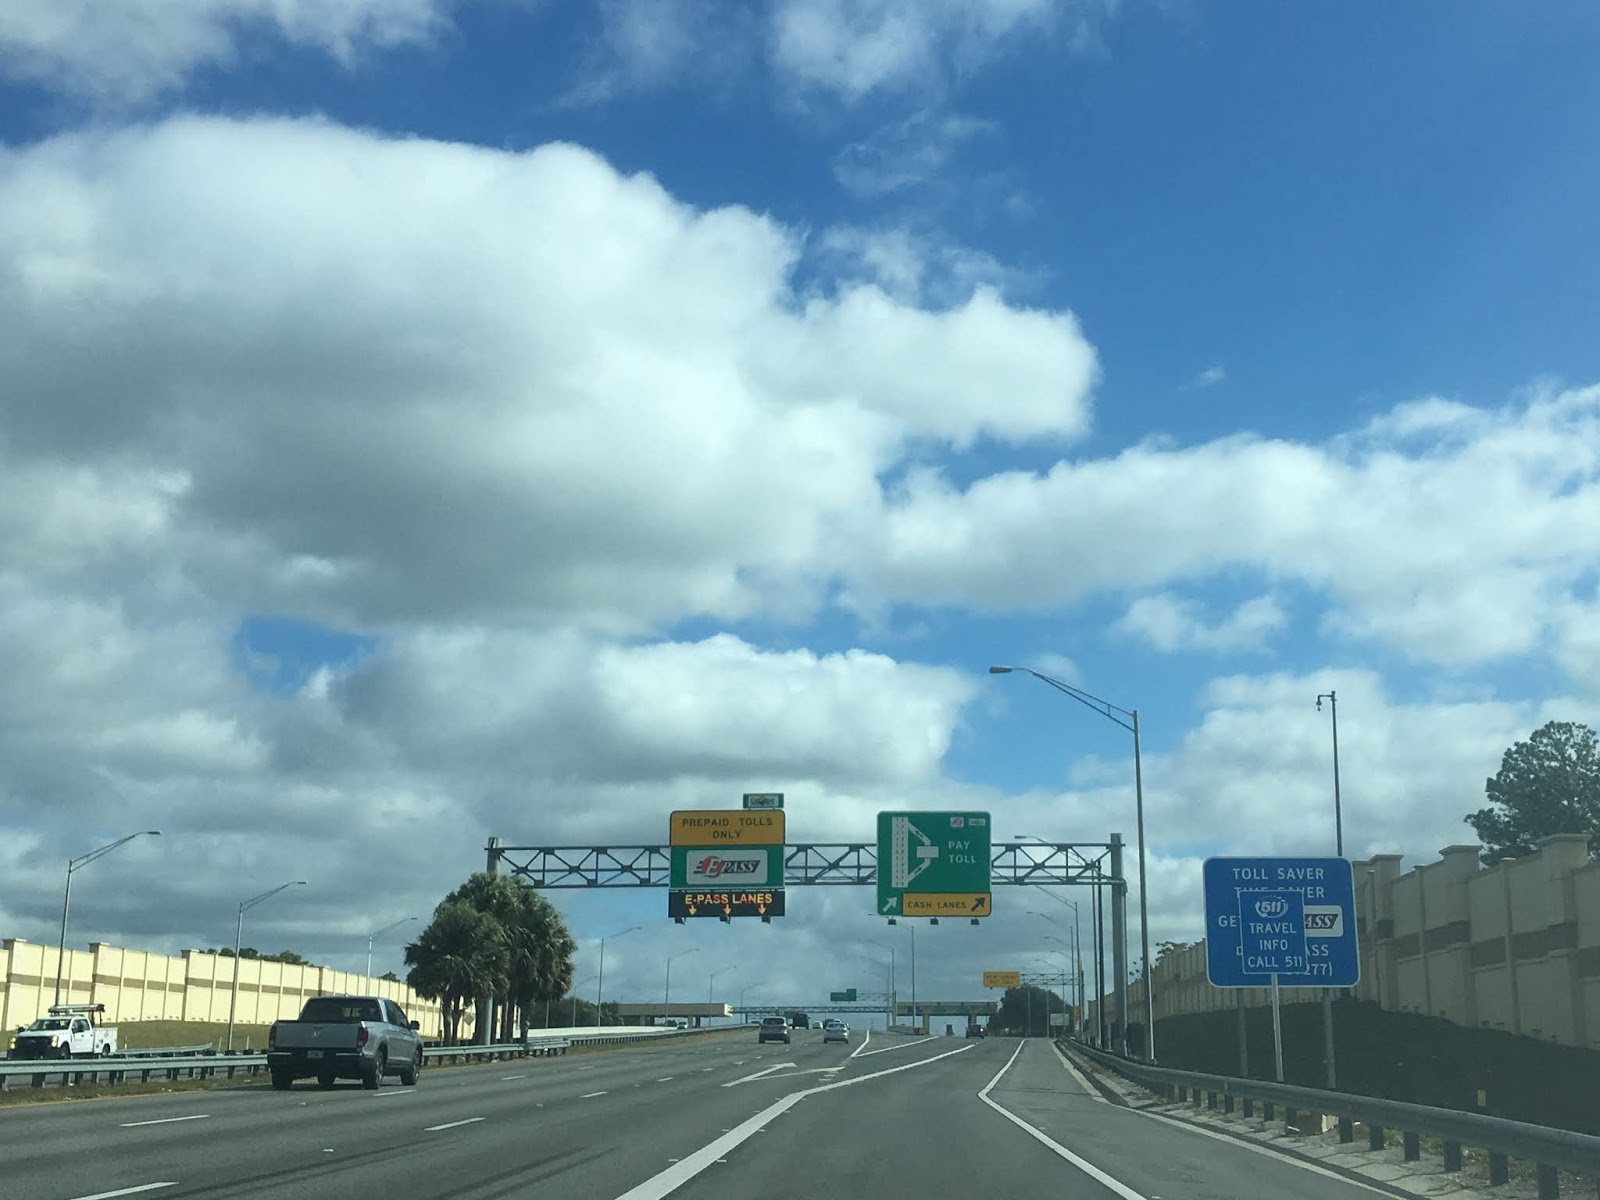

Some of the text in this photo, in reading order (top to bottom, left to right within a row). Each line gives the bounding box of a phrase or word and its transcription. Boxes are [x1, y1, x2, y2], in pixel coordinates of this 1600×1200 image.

[682, 817, 773, 827] PREPAID TOLLS
[712, 830, 742, 839] ONLY
[948, 840, 971, 850] PAY
[949, 854, 977, 863] TOLL
[1232, 868, 1324, 880] TOLL SAVER
[684, 894, 773, 904] E-PASS LANES
[907, 901, 967, 909] CASH LANES
[1261, 901, 1281, 913] 511
[1218, 915, 1240, 927] GE
[1249, 923, 1297, 934] TRAVEL
[1259, 939, 1288, 951] INFO
[1248, 956, 1302, 968] CALL 511
